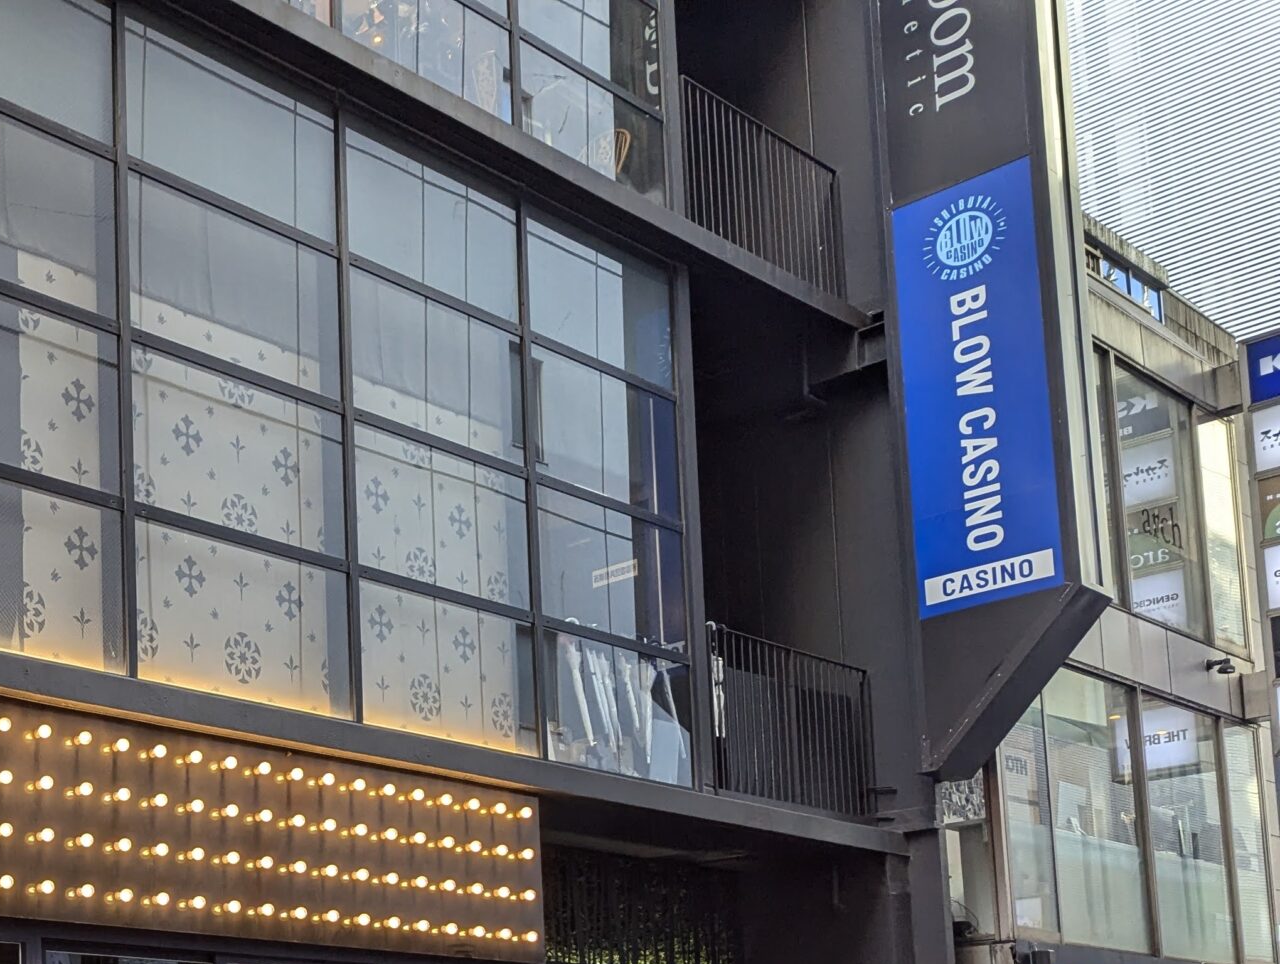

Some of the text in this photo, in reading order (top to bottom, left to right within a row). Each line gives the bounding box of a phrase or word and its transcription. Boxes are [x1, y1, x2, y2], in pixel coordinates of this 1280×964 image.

[933, 195, 992, 227] SHIBUYA
[940, 215, 989, 252] BLOW
[946, 238, 984, 262] CASINO
[940, 254, 992, 280] CASINO
[949, 284, 1005, 552] BLOW CASINO
[1141, 507, 1184, 550] arch
[941, 558, 1034, 597] CASINO
